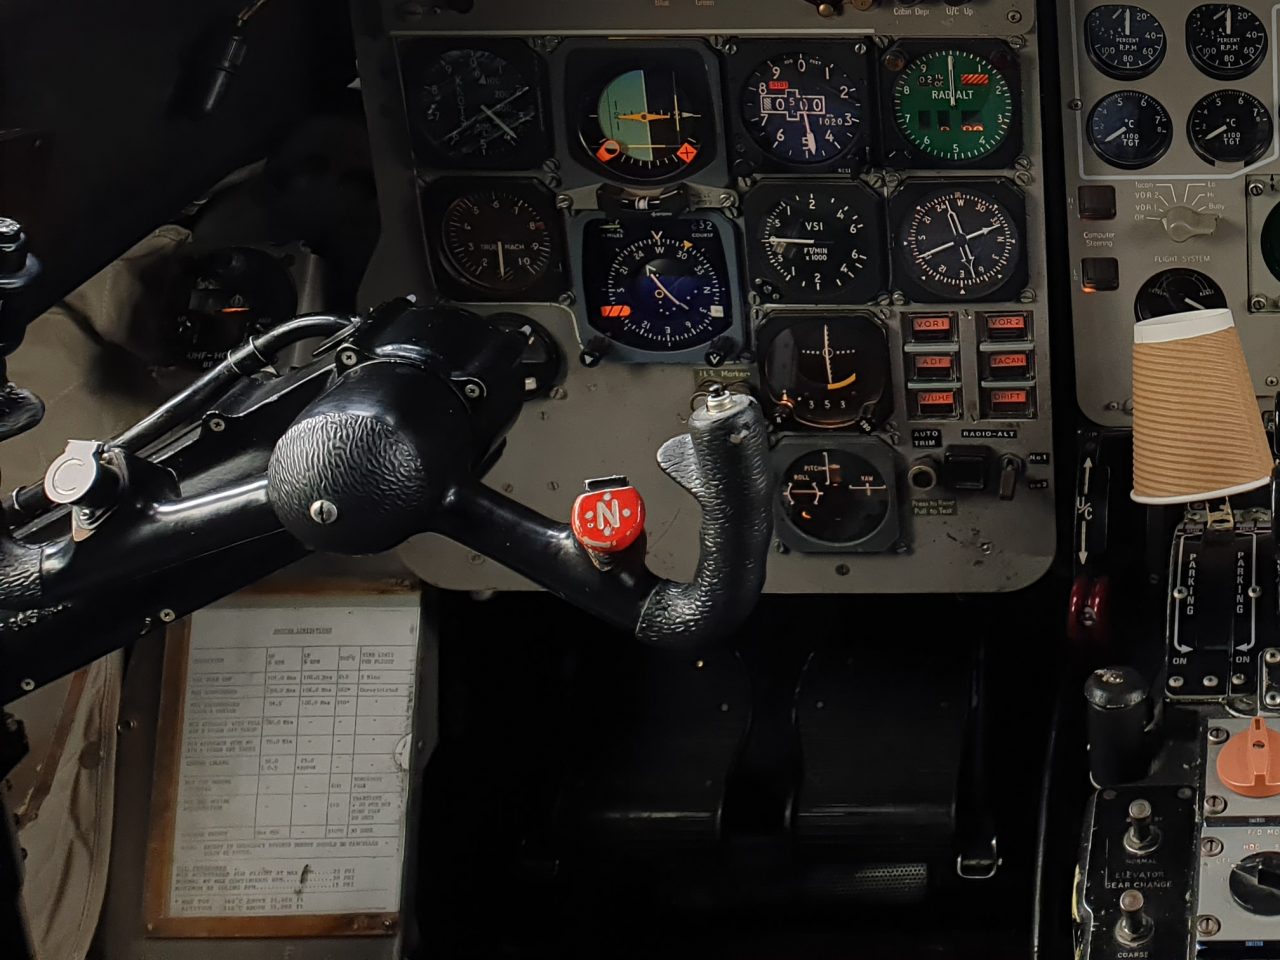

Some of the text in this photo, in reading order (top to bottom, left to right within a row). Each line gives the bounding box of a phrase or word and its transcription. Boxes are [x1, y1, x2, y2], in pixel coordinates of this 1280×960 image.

[893, 7, 913, 17] Cabin
[1116, 36, 1140, 44] PERCENT
[1217, 36, 1241, 44] PERCENT
[931, 89, 975, 101] RAD ALT
[1121, 139, 1140, 147] TGT
[804, 221, 825, 232] VSI
[1083, 230, 1116, 240] Computer
[480, 242, 525, 252] TRUE MACH
[1085, 239, 1114, 248] Steering
[803, 246, 829, 256] FT/MIN
[1154, 255, 1212, 263] FLIGHT SYSTEM
[992, 356, 1025, 366] TACAN
[920, 393, 951, 403] V/UHF
[992, 392, 1021, 401] DRIFT
[913, 430, 939, 438] AUTO
[962, 430, 1016, 438] RADIO-ALT
[802, 465, 823, 473] PITCH
[793, 472, 811, 482] ROLL
[860, 474, 874, 482] YAW
[595, 498, 621, 530] N
[913, 507, 927, 515] Pull
[1076, 497, 1093, 522] U/C
[1186, 553, 1198, 616] PARKING
[1236, 551, 1246, 615] PARKING
[1172, 656, 1188, 666] ON
[1235, 655, 1250, 665] ON
[1115, 870, 1165, 880] ELEVATOR
[1133, 880, 1173, 889] CHANGE
[1117, 951, 1150, 960] COARSE
